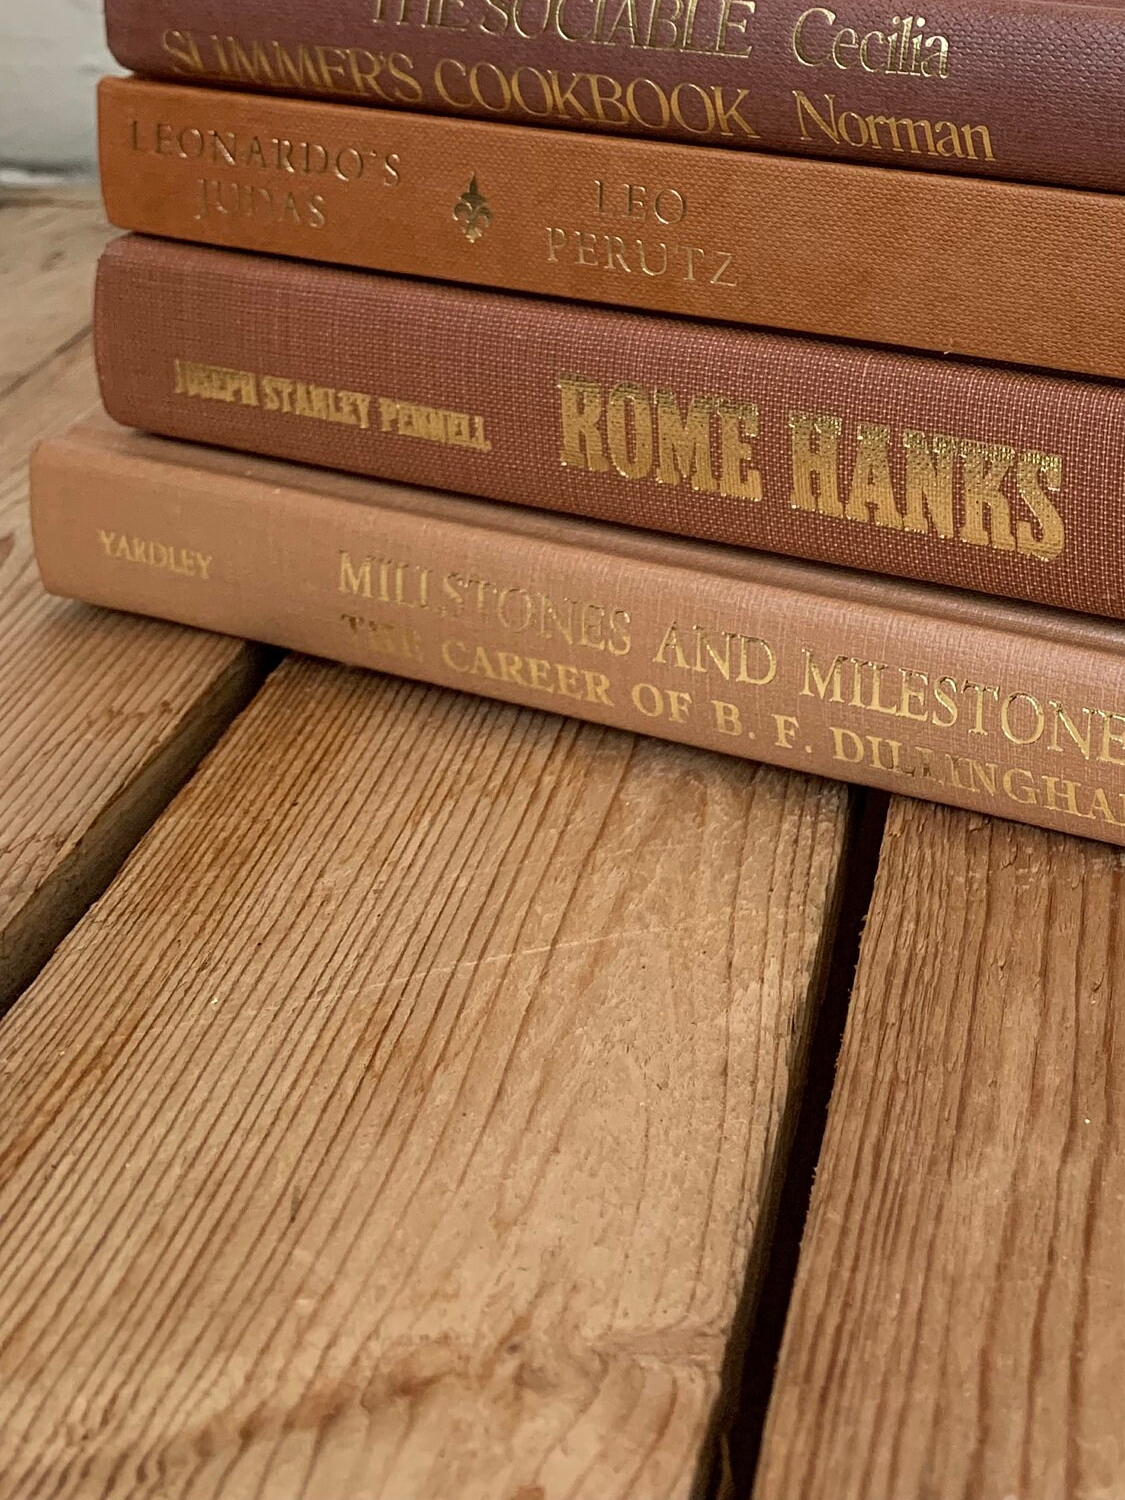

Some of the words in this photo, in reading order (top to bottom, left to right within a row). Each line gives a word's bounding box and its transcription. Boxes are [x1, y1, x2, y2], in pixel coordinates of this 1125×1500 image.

[792, 6, 951, 79] Cecilia
[434, 58, 760, 138] COOKBOOK
[792, 89, 996, 162] Norman
[128, 118, 401, 187] LEONARDO'S
[594, 179, 689, 226] LEO
[545, 227, 738, 288] PERUTZ
[174, 358, 258, 407] JOSEPH
[261, 374, 374, 430] STANLEY
[379, 395, 493, 453] PENNELL
[554, 372, 763, 501] ROME
[788, 412, 1065, 562] HANKS
[98, 528, 213, 580] YARDLEY
[337, 548, 632, 656] MILLSTONES
[653, 619, 778, 686] AND
[441, 640, 615, 706] CAREER
[632, 681, 693, 725] OF
[713, 701, 756, 739] B.
[773, 714, 813, 754] F.
